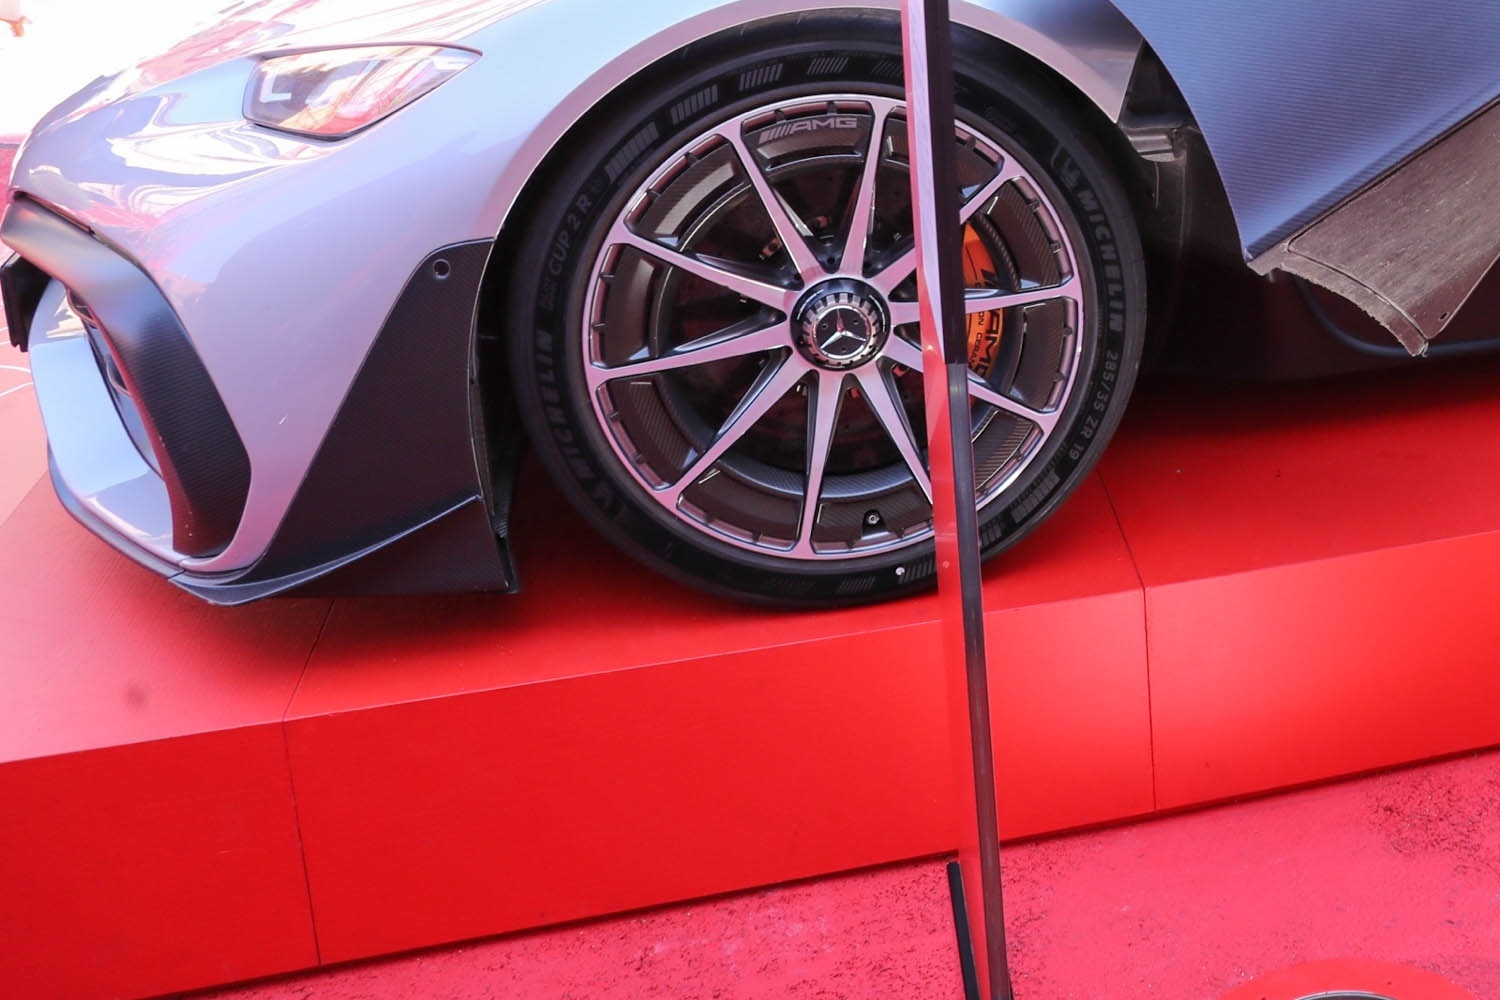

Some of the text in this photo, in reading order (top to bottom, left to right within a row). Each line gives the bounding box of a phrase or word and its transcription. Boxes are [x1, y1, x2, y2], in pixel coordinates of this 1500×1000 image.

[788, 117, 859, 135] AMG
[548, 230, 571, 276] CUP
[1076, 187, 1125, 333] MICHELIN
[535, 329, 596, 481] MICHELIN
